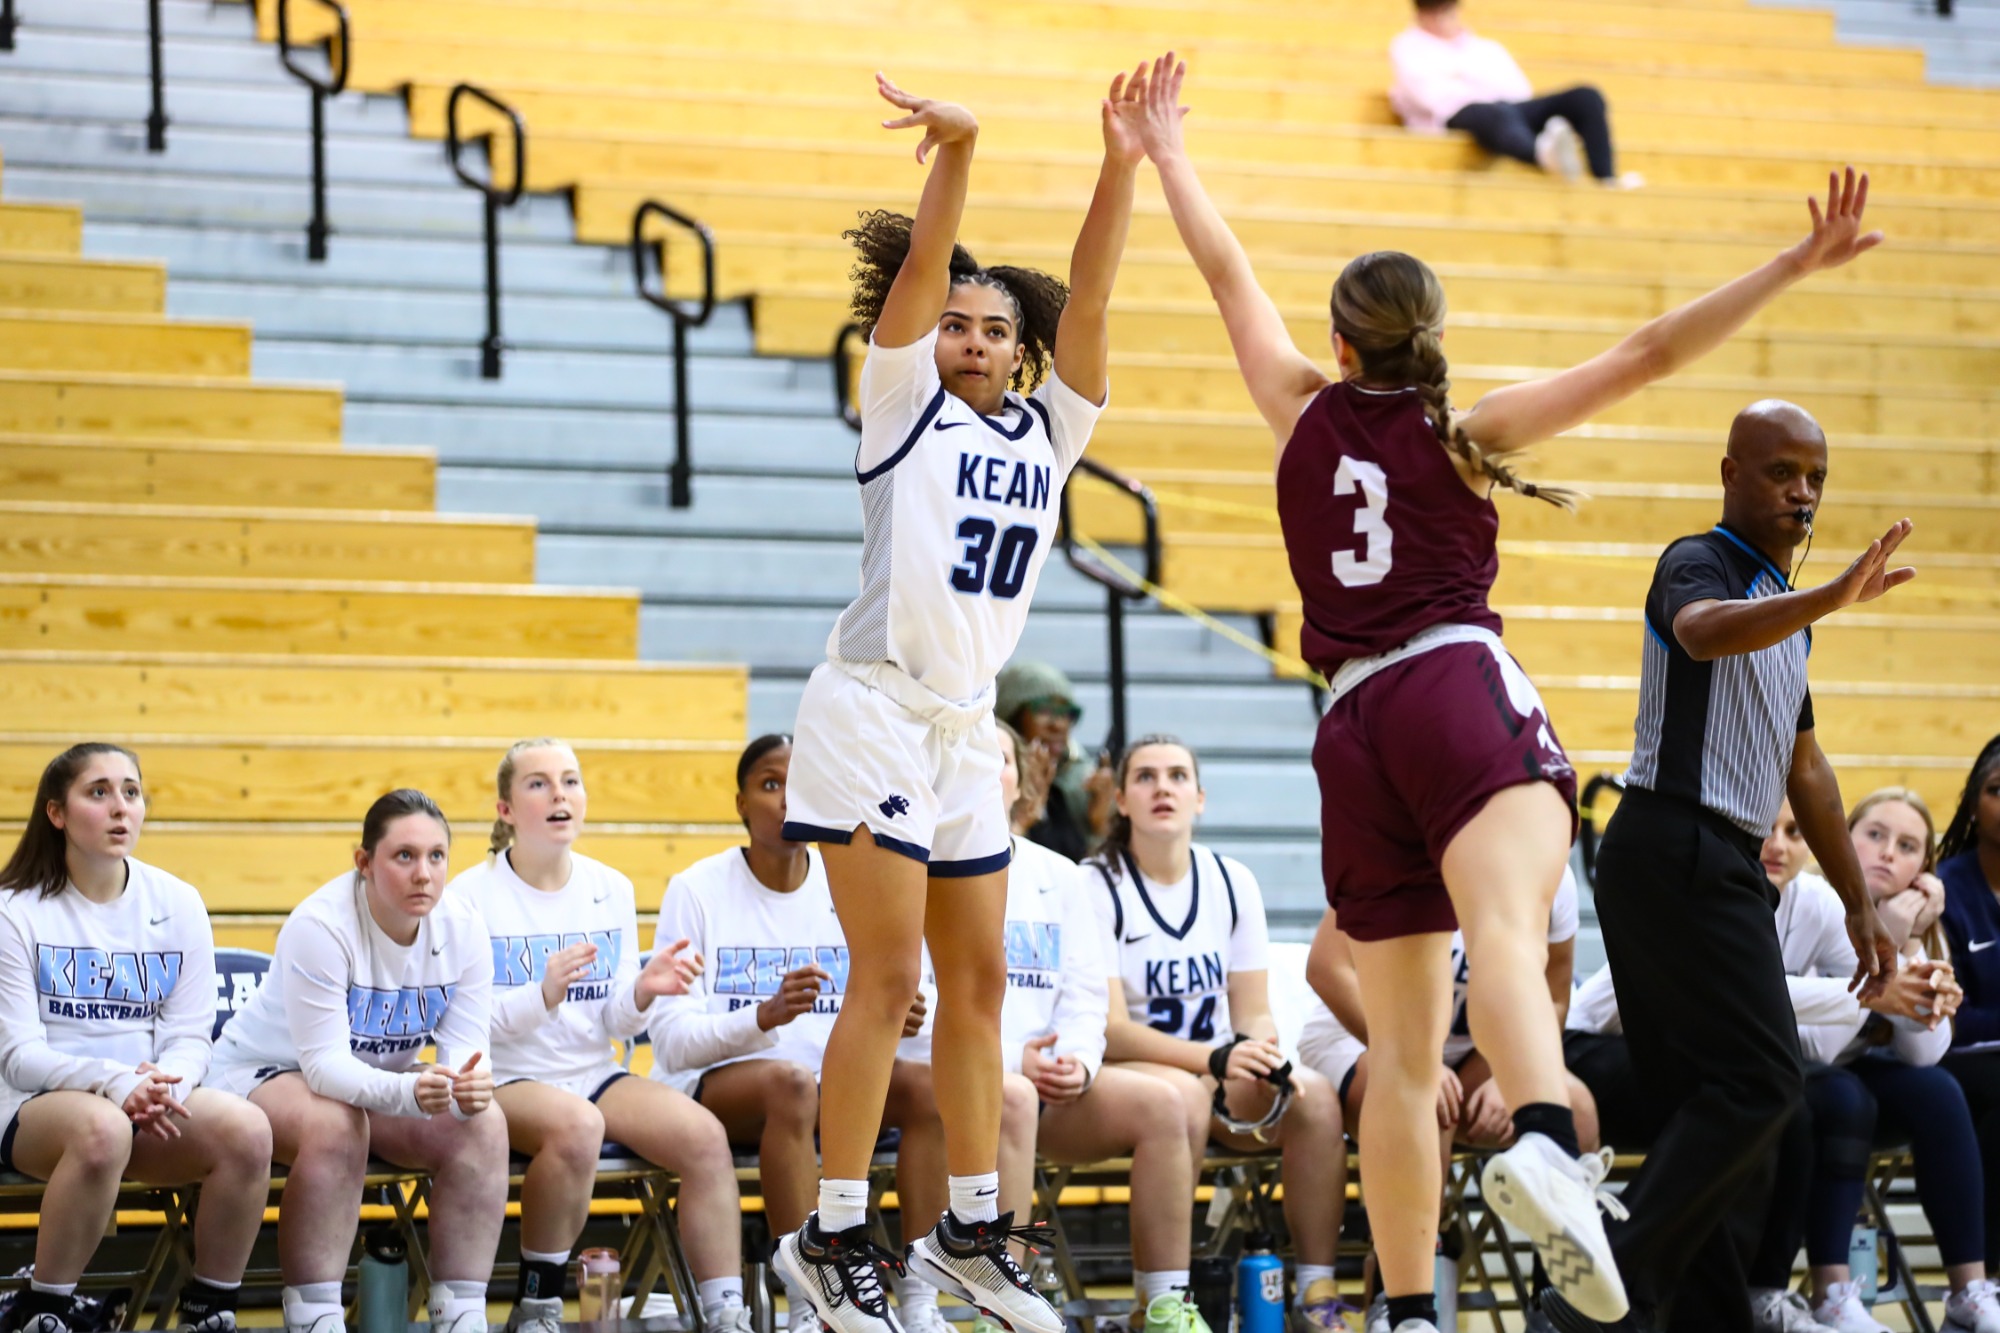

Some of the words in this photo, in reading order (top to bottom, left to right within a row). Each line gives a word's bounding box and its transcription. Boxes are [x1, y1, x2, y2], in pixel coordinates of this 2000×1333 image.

[956, 452, 1051, 511] KEAN
[1331, 454, 1393, 587] 3
[949, 515, 1040, 601] 30
[36, 943, 184, 1004] KEAN
[1146, 951, 1223, 997] KEAN
[1148, 995, 1217, 1042] 24
